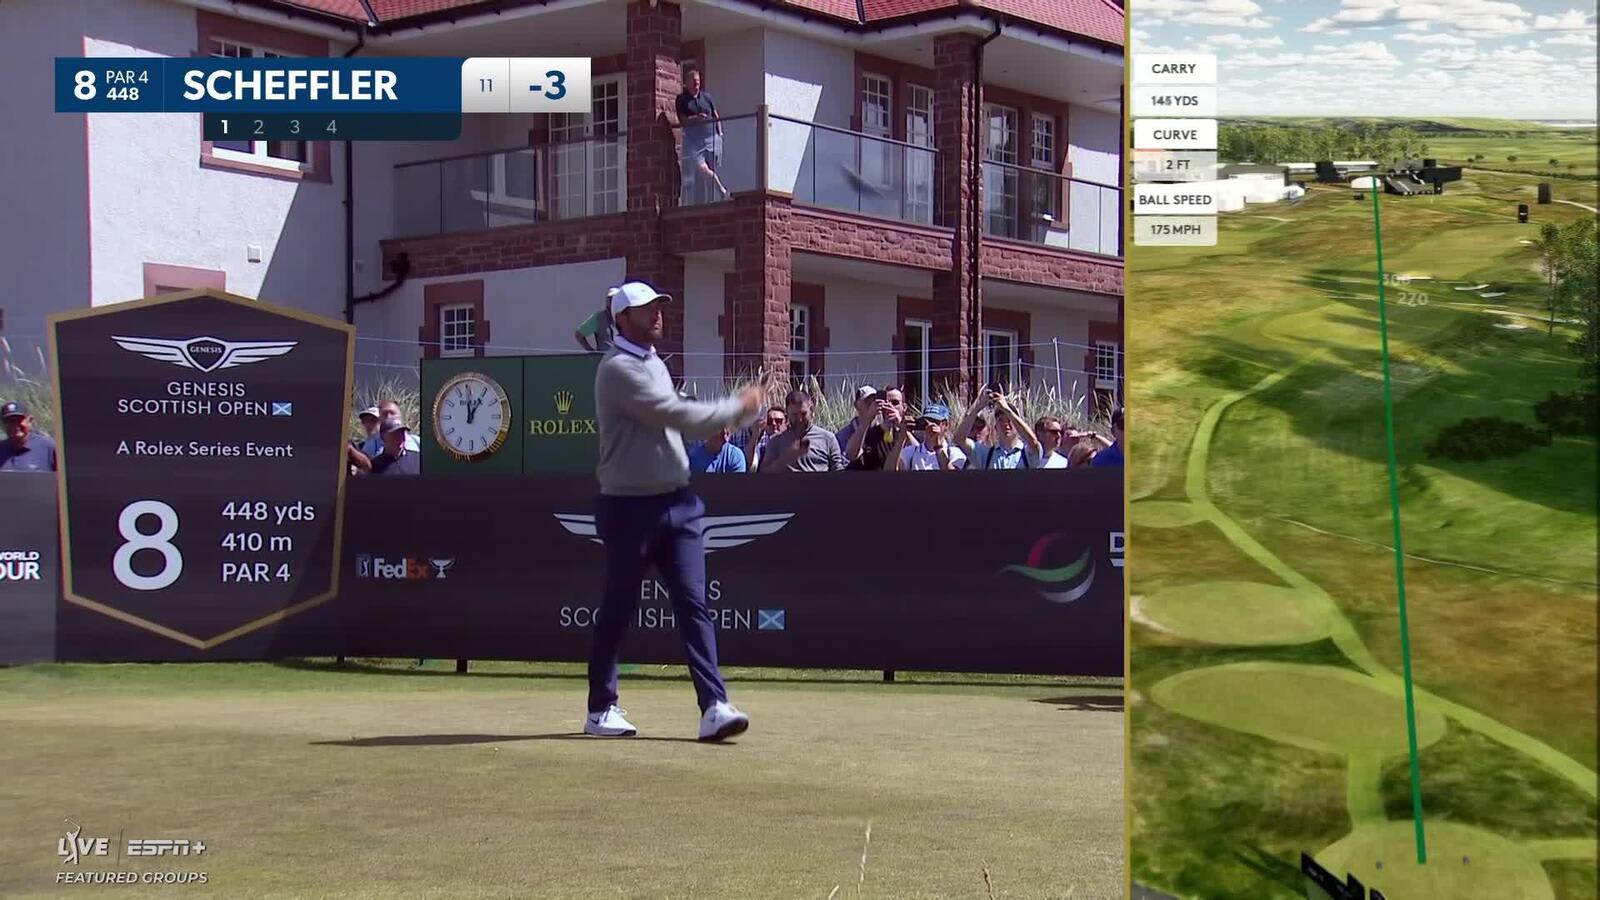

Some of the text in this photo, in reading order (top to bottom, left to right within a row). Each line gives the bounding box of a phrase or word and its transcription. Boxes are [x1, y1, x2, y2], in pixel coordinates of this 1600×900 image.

[190, 345, 223, 354] GENESIS
[167, 381, 246, 397] GENESIS
[118, 400, 268, 416] SCOTTISH OPEN
[530, 419, 597, 435] ROLEX
[116, 441, 293, 457] A Rolex Series Event
[222, 501, 315, 525] 448 yds
[112, 499, 184, 591] 8
[222, 532, 293, 552] 410 m
[222, 563, 291, 582] PAR 4
[374, 558, 430, 578] FedEx
